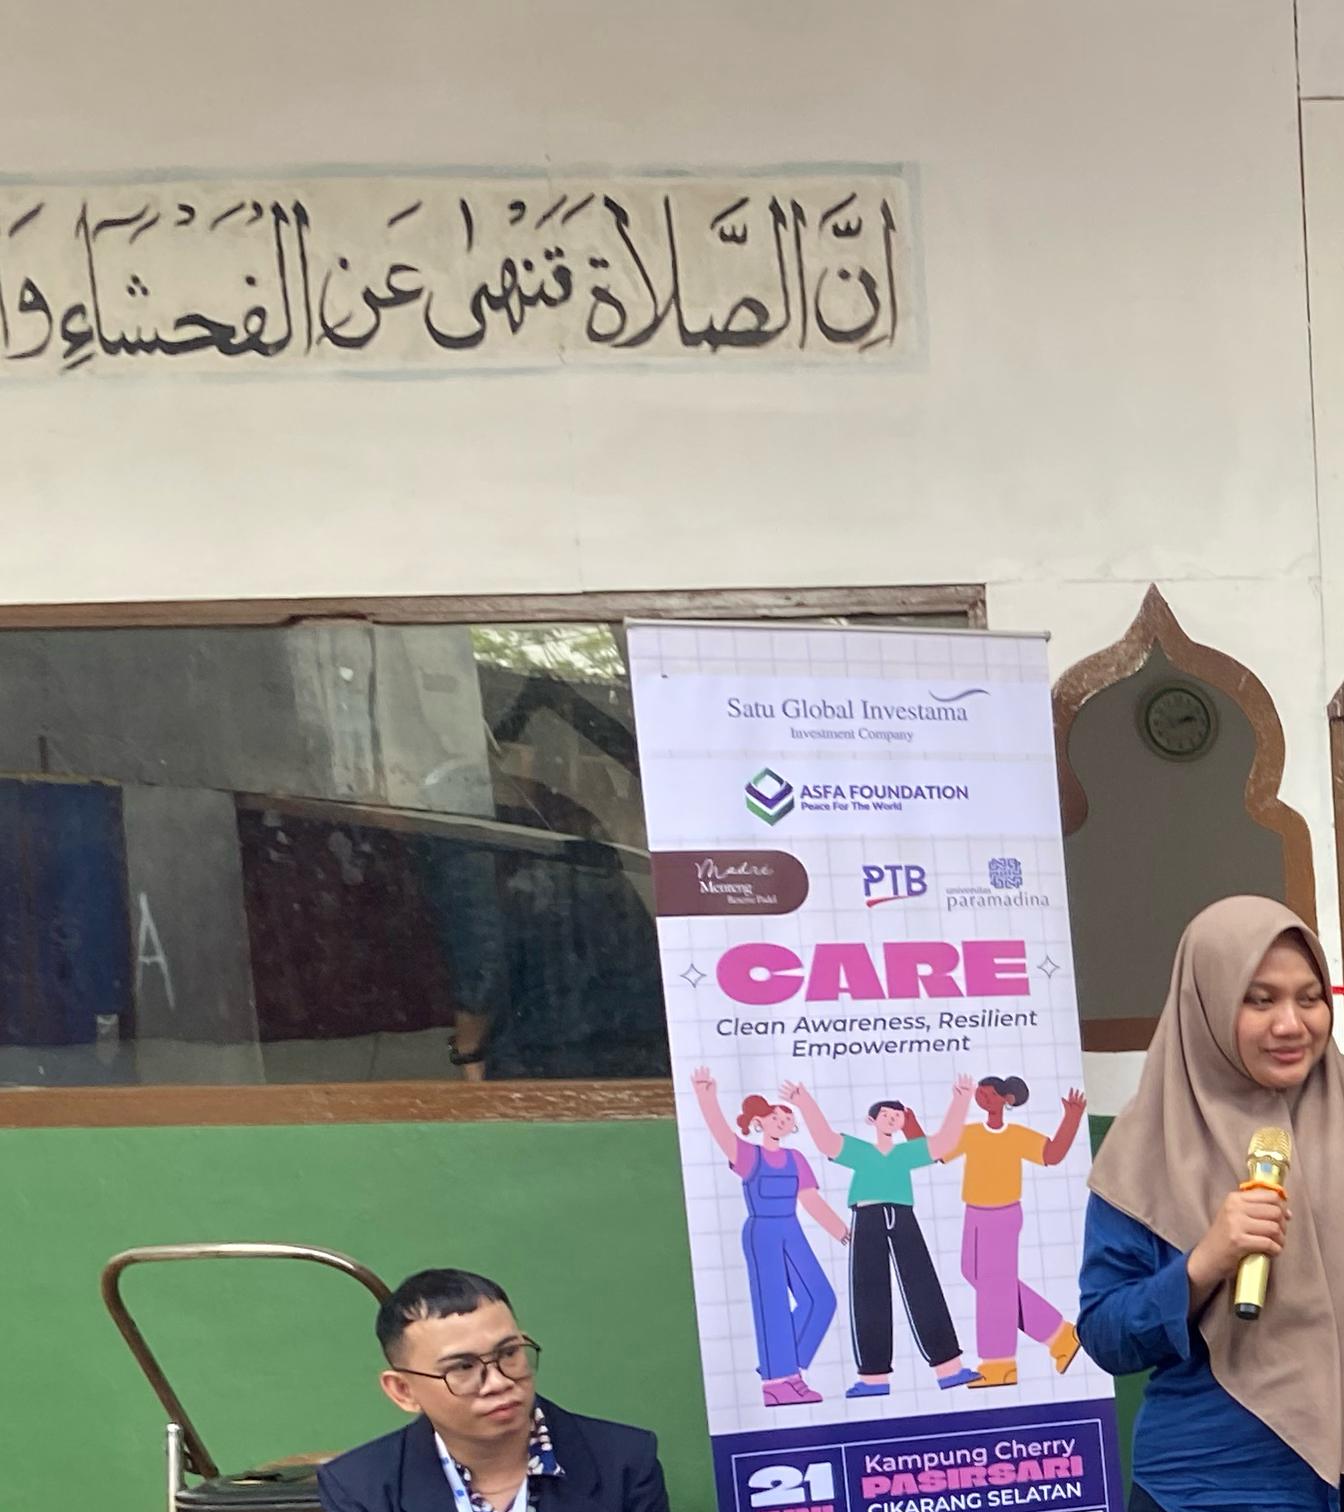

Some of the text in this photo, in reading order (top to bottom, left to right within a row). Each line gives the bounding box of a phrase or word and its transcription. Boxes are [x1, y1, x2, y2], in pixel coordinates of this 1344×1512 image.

[727, 697, 968, 722] Satu Global Investama
[790, 727, 914, 743] Investment Company
[800, 784, 969, 801] ASFA FOUNDATION
[800, 801, 902, 812] Peace For The World
[699, 880, 754, 897] Menteng
[862, 864, 929, 899] PTB
[946, 890, 1051, 912] paramadina
[716, 939, 1031, 1006] CARE
[716, 1008, 1038, 1037] Clean Awareness, Resilient
[791, 1034, 971, 1060] Empowerment
[864, 1438, 1077, 1474] Kampung Cherry
[747, 1461, 835, 1508] 21
[861, 1454, 1085, 1499] PASIRSARI
[987, 1481, 1082, 1509] SELATAN
